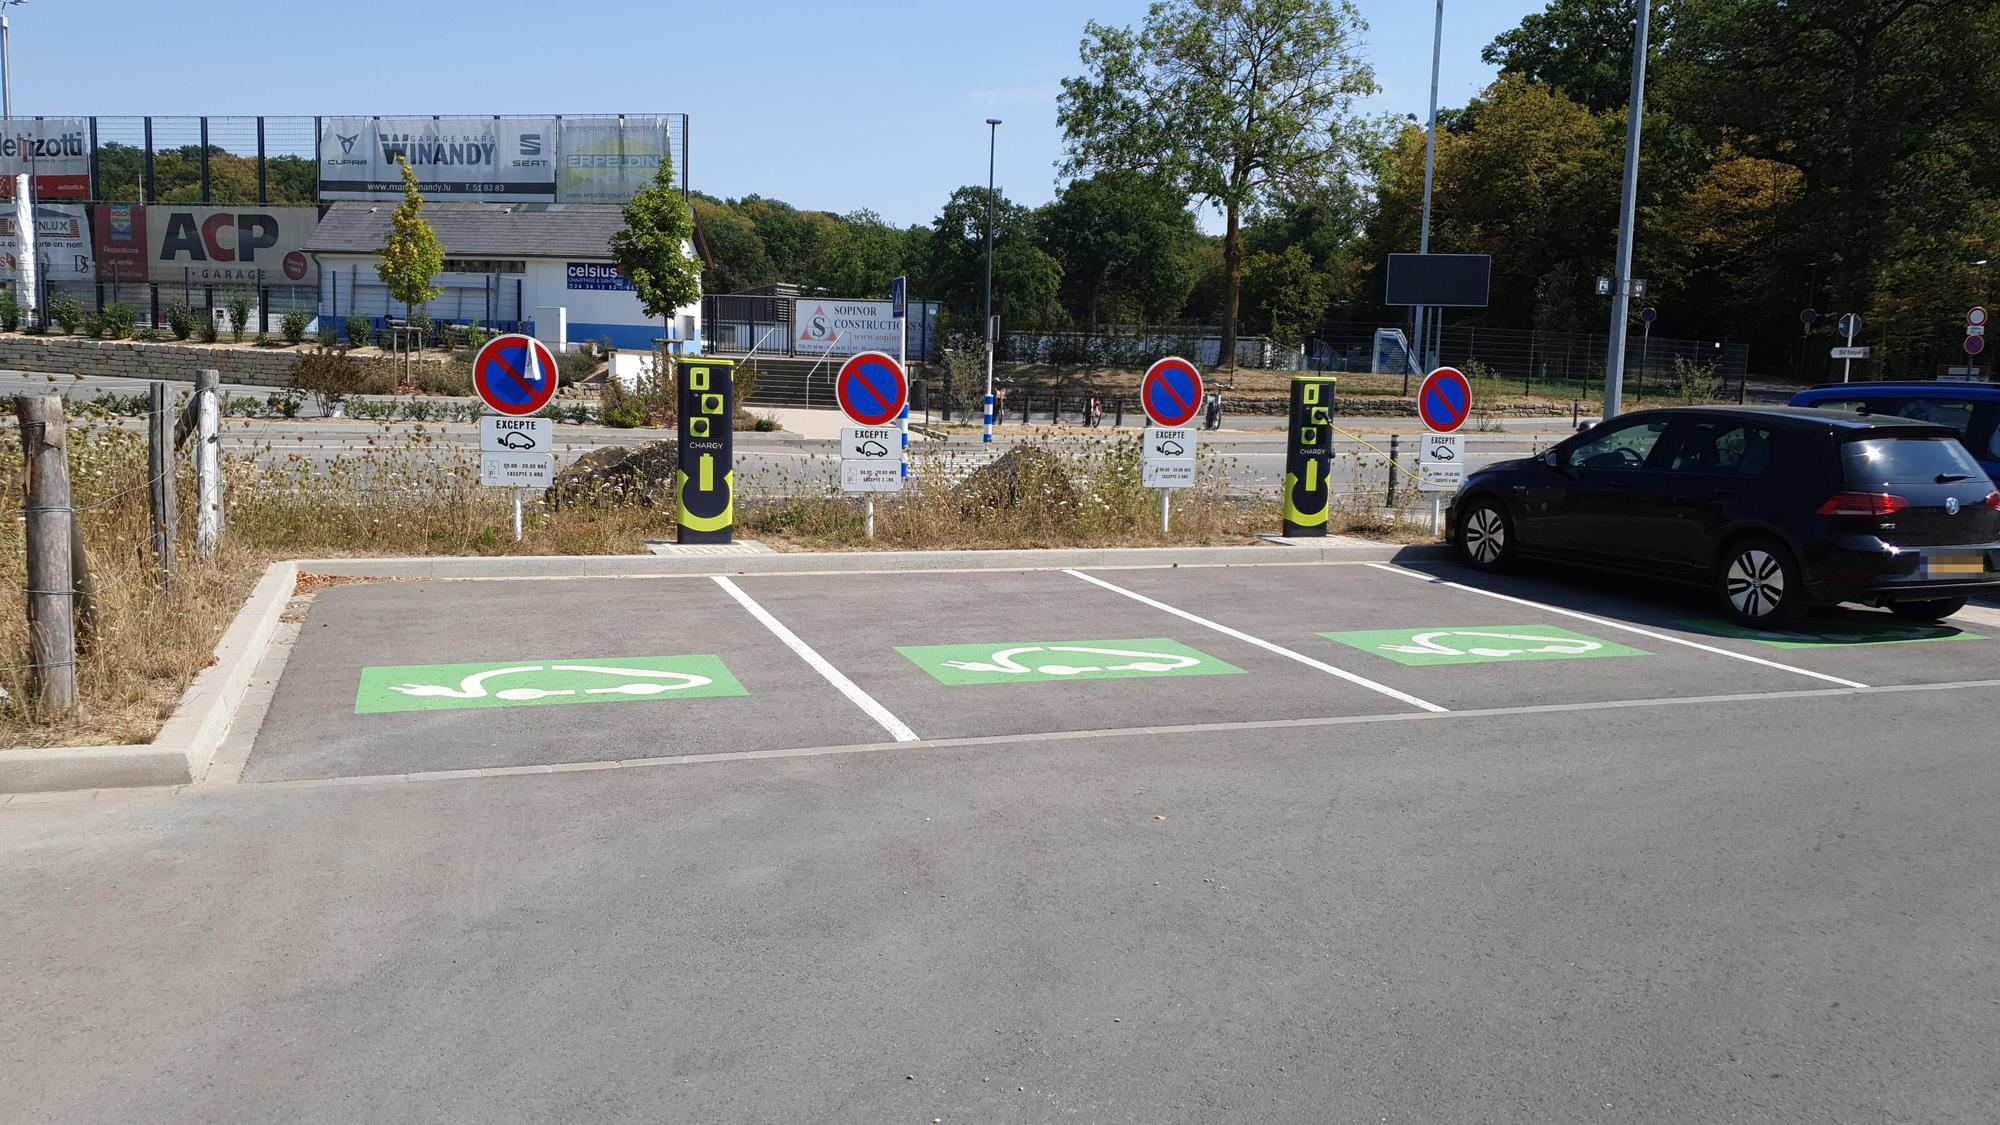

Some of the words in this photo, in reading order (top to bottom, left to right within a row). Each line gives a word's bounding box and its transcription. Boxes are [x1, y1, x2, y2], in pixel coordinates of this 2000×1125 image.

[410, 135, 457, 143] GARAGE
[463, 135, 496, 143] MARC
[379, 133, 496, 165] WINANDY
[512, 159, 548, 167] SEAT
[567, 155, 660, 168] ERPELDIN
[159, 212, 280, 262] ACP
[202, 269, 267, 280] GARAGE
[568, 263, 618, 277] celsius
[834, 305, 877, 316] SOPINOR
[496, 420, 536, 430] EXCEPTE
[854, 430, 889, 439] EXCEPTE
[1155, 431, 1185, 439] EXCEPTE
[689, 441, 724, 450] CHARGY
[1431, 436, 1456, 445] EXCEPTE
